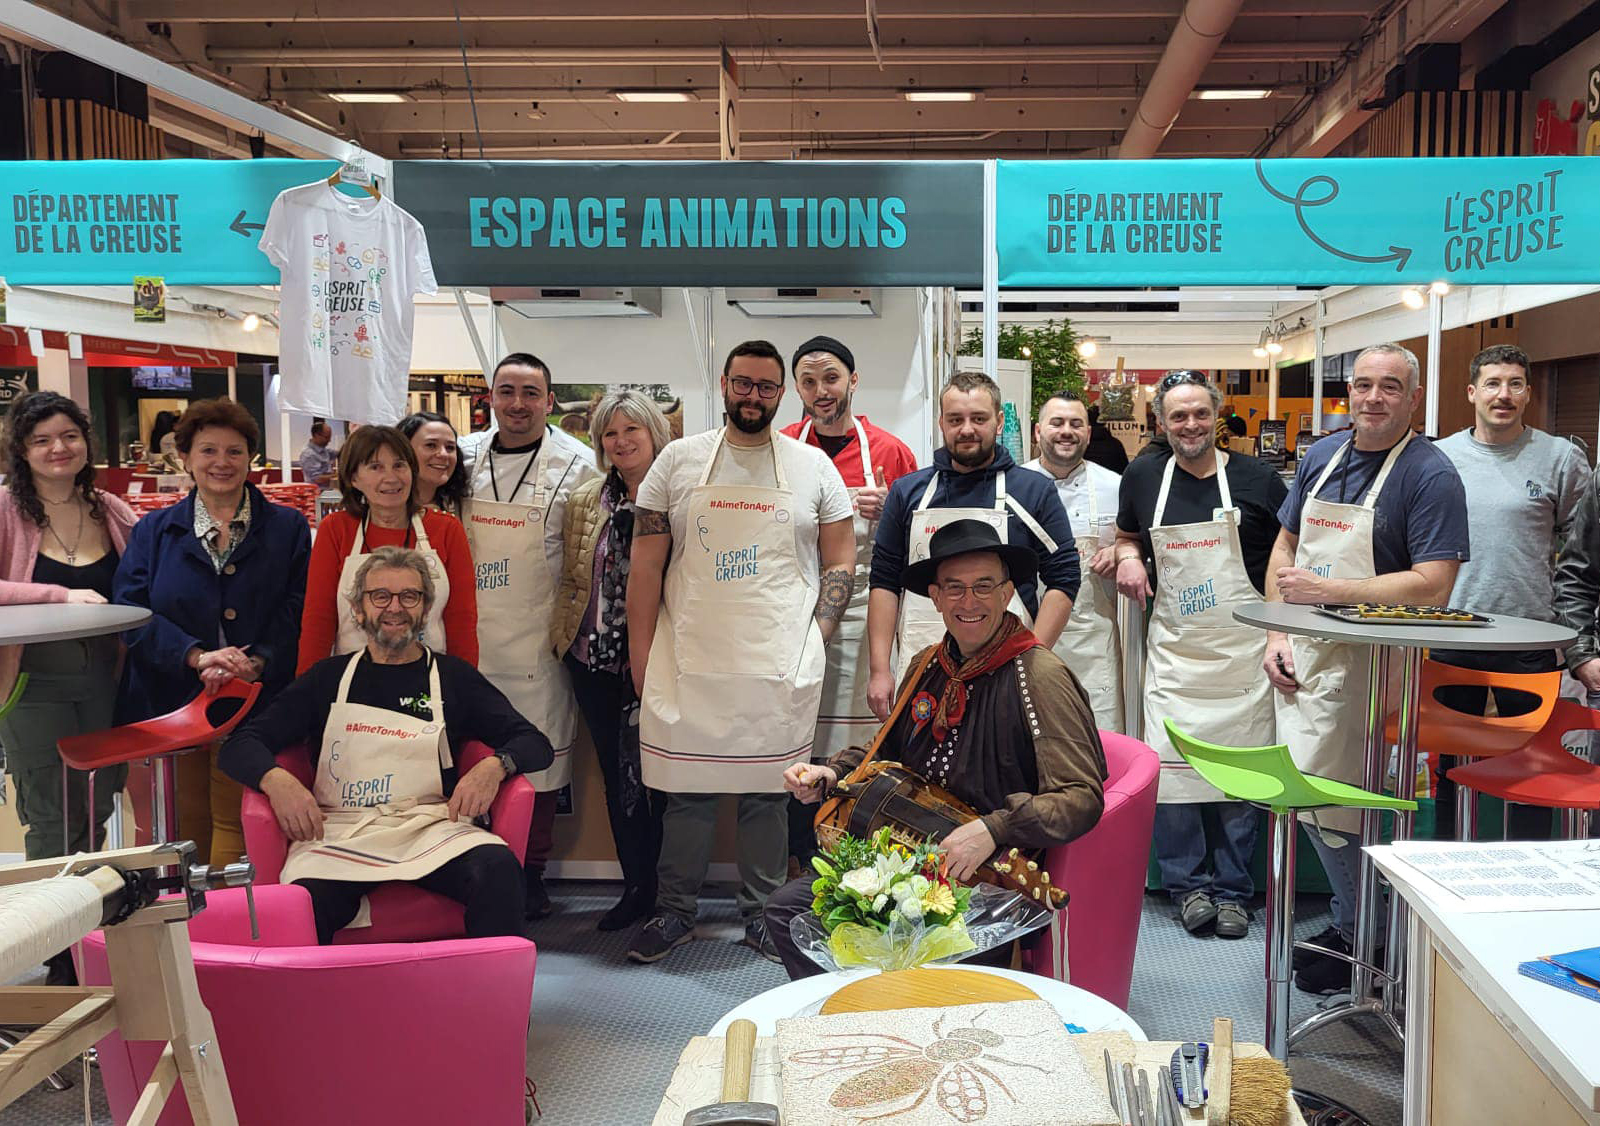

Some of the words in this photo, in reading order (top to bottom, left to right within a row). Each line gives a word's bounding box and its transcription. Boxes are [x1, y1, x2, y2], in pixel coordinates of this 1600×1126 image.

[12, 188, 179, 222] DÉPARTEMENT
[1047, 187, 1223, 222] DÉPARTEMENT
[1443, 169, 1564, 234] L'ESPRIT
[469, 197, 627, 249] ESPACE
[640, 197, 908, 249] ANIMATIONS
[14, 224, 44, 253] DE
[51, 224, 82, 253] LA
[89, 224, 182, 253] CREUSE
[1047, 224, 1077, 254] DE
[1085, 224, 1116, 254] LA
[1125, 223, 1223, 254] CREUSE
[1444, 215, 1564, 273] CREUSE
[709, 500, 776, 513] #AimeTonAgri
[715, 544, 760, 567] L'ESPRIT
[475, 574, 510, 591] REUSE
[715, 561, 760, 581] CREUSE
[1180, 593, 1218, 616] CREUSE
